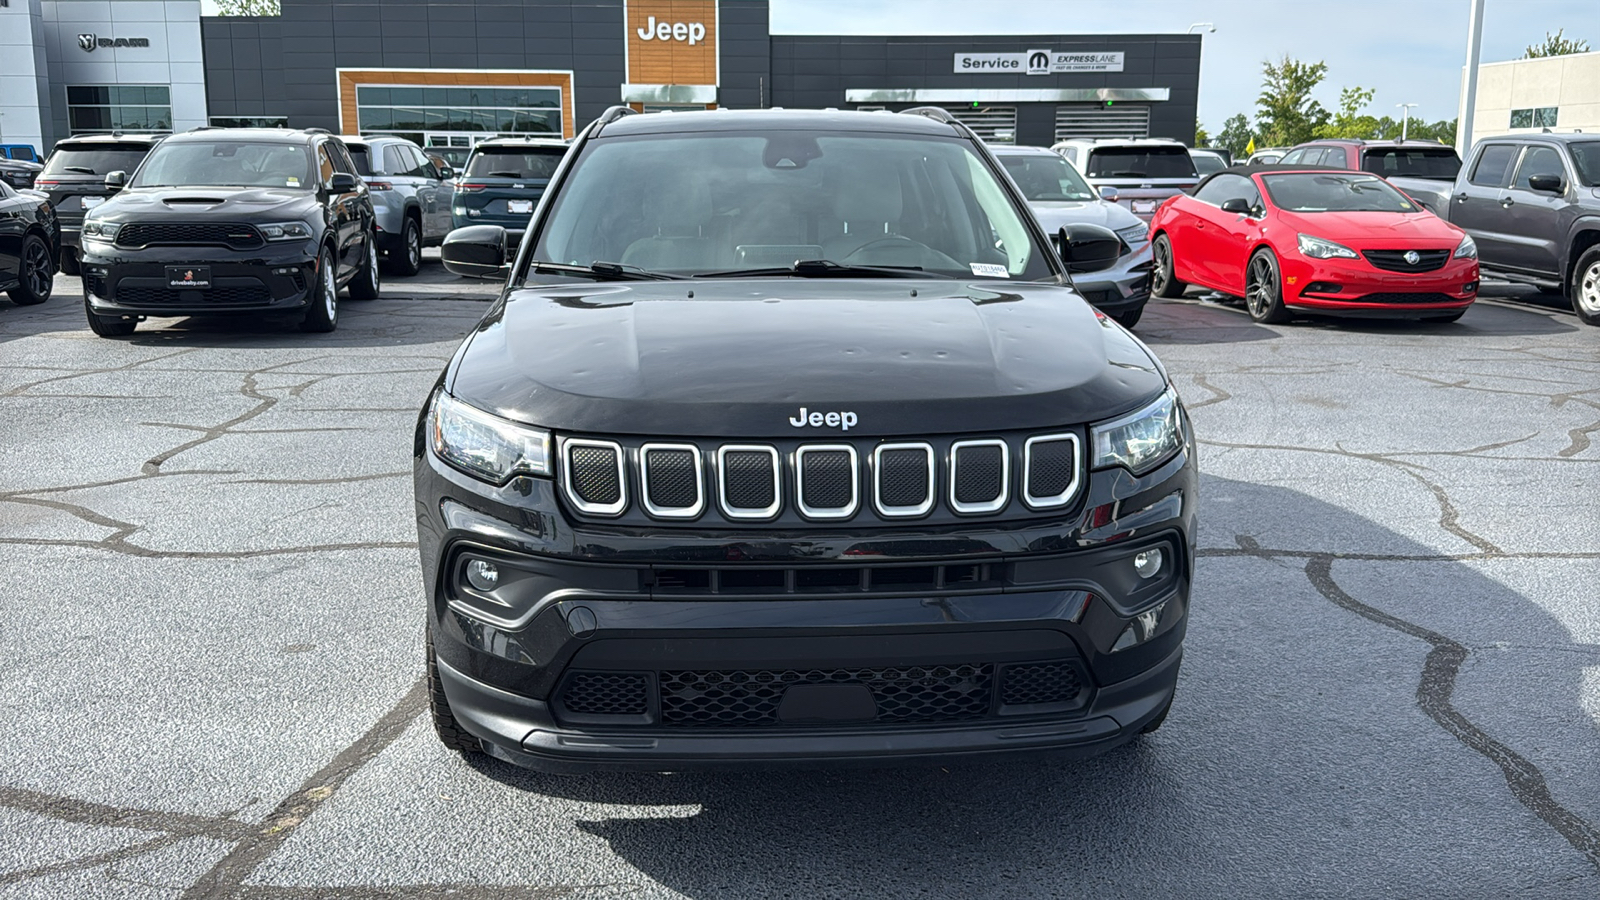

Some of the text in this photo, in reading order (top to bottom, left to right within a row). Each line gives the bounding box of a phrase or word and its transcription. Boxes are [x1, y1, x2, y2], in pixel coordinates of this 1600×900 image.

[637, 16, 706, 45] Jeep
[98, 38, 149, 47] RAM
[962, 57, 1019, 68] Service
[789, 407, 858, 431] Jeep
